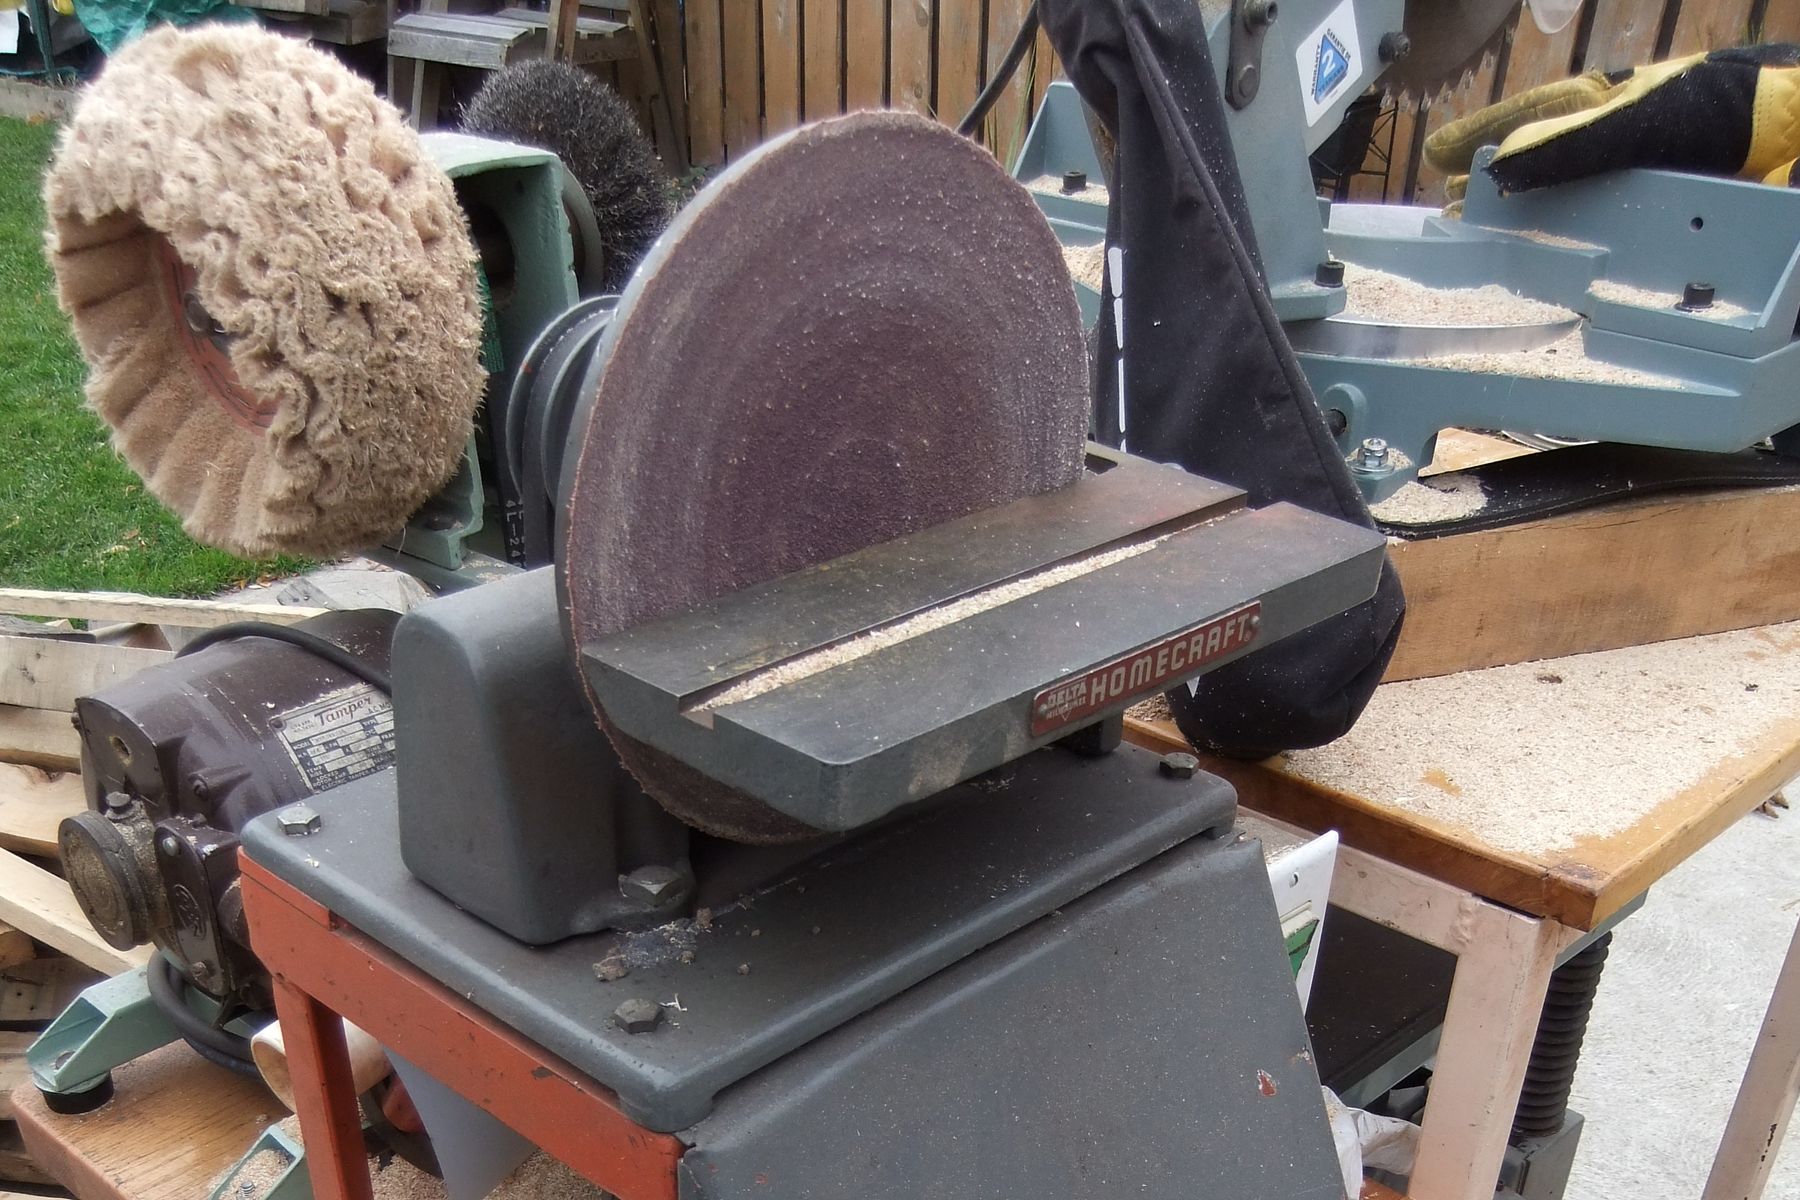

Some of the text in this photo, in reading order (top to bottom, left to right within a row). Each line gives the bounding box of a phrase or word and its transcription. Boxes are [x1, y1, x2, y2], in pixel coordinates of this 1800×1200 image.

[1311, 44, 1320, 96] WARRANTY
[1322, 49, 1335, 78] 2
[1089, 613, 1250, 706] HOMECRAFT
[1047, 681, 1087, 709] DELTA
[314, 695, 371, 727] Tamper
[293, 741, 311, 750] MODEL
